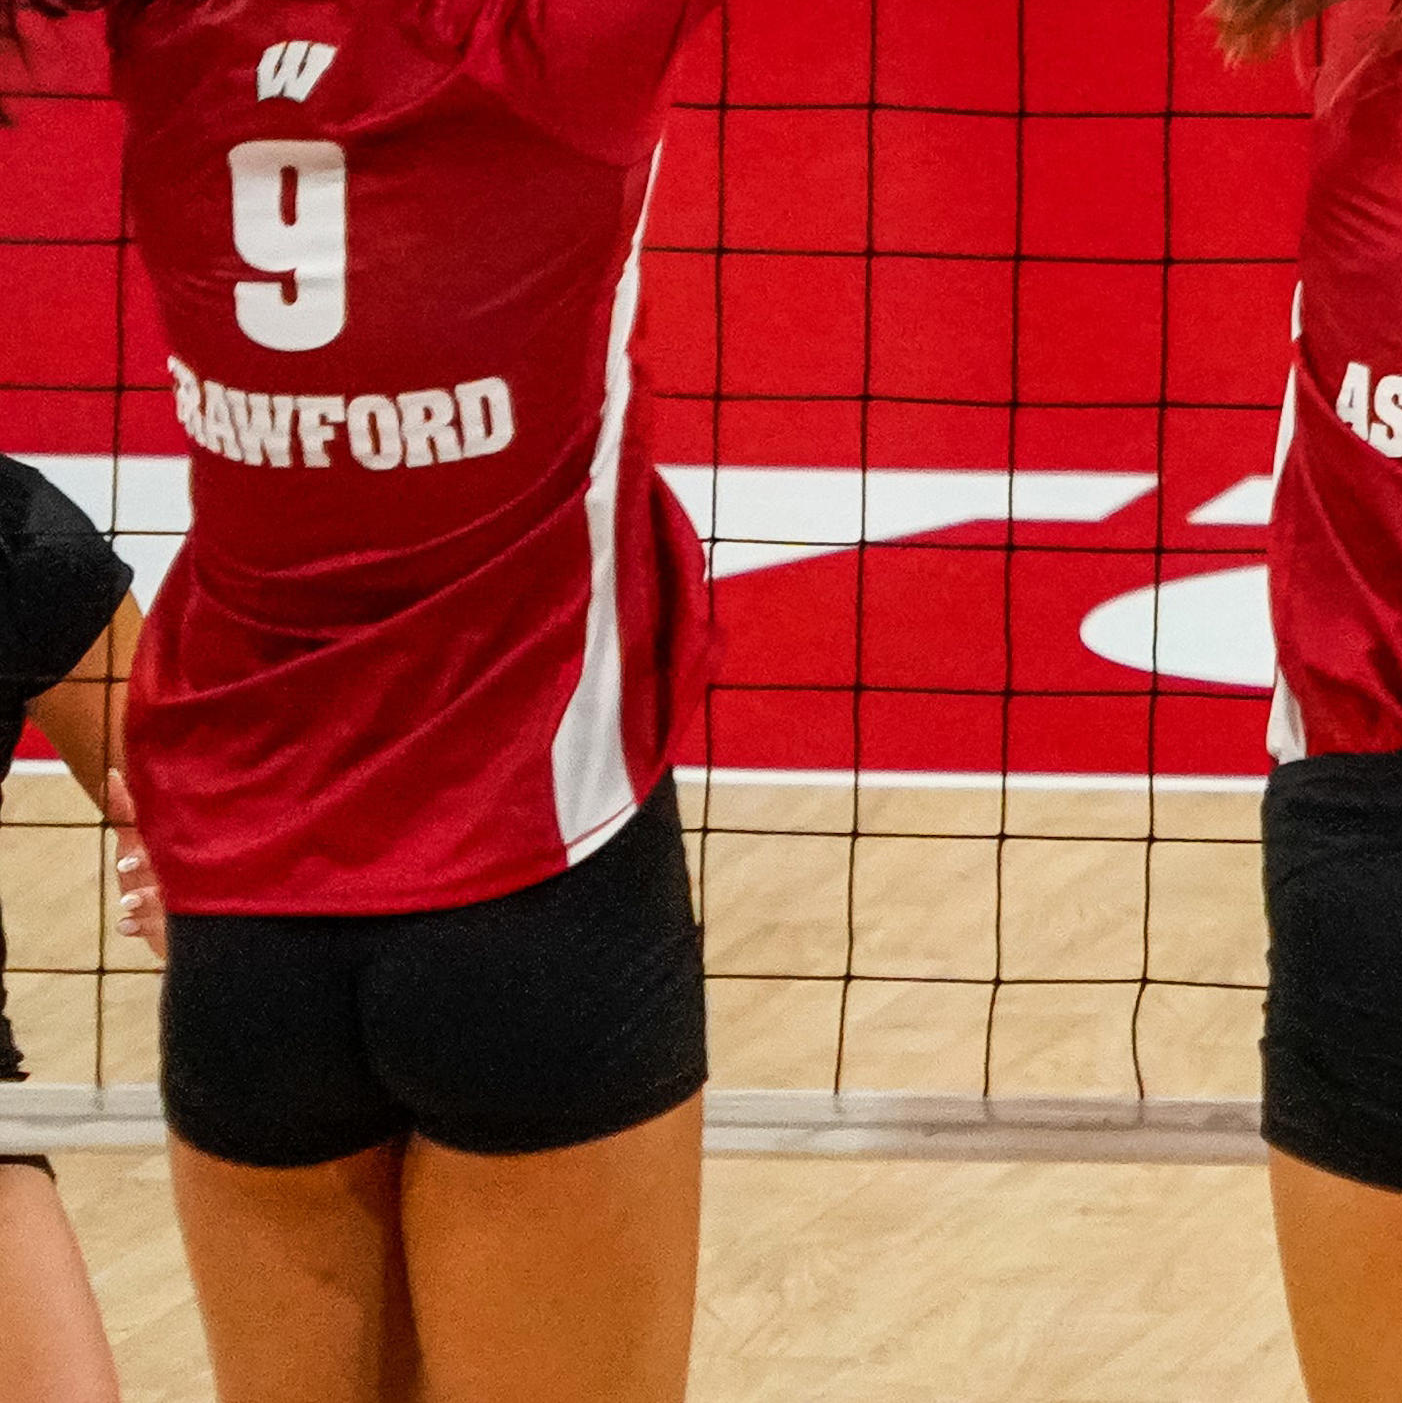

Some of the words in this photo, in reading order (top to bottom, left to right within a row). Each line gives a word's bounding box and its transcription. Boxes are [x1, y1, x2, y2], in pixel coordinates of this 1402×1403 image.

[255, 40, 339, 103] W
[228, 138, 347, 352] 9
[167, 355, 515, 471] RAWFORD
